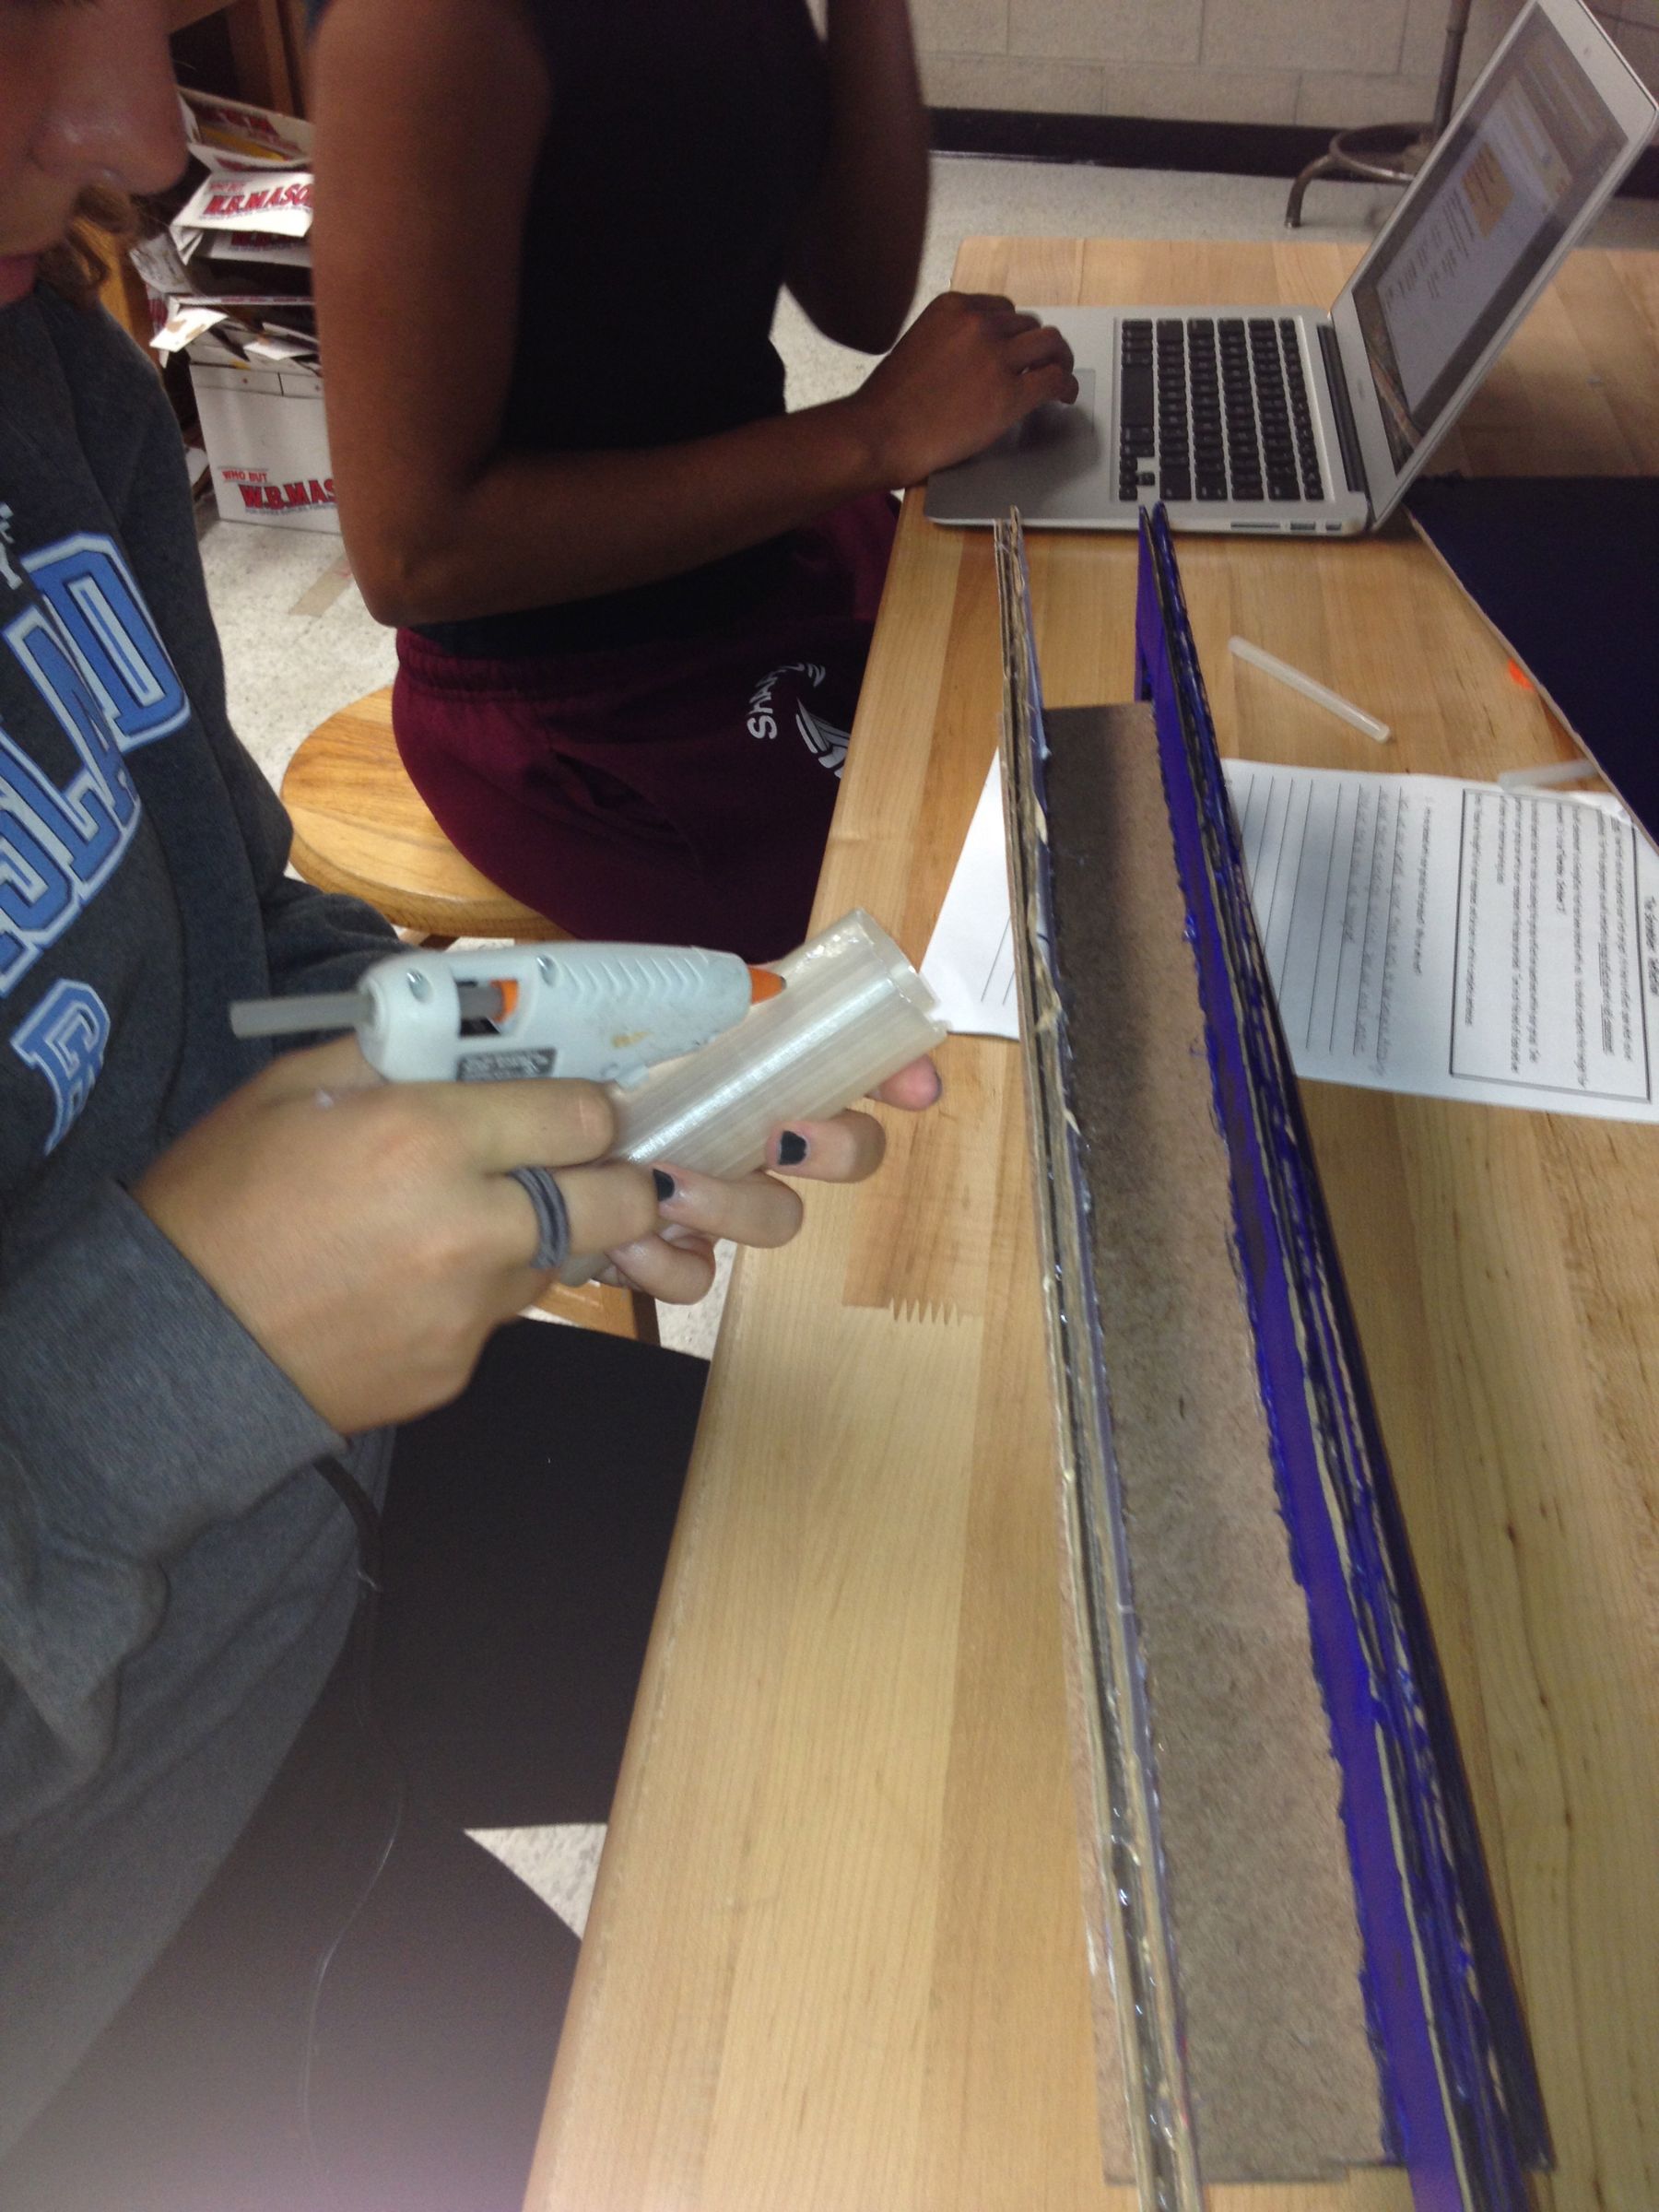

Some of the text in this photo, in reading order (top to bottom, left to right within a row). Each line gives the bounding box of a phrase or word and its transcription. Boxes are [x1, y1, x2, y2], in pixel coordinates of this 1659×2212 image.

[203, 183, 312, 215] W.B.MASO
[222, 470, 267, 482] WHO BUT
[238, 477, 335, 510] W.B.MAS
